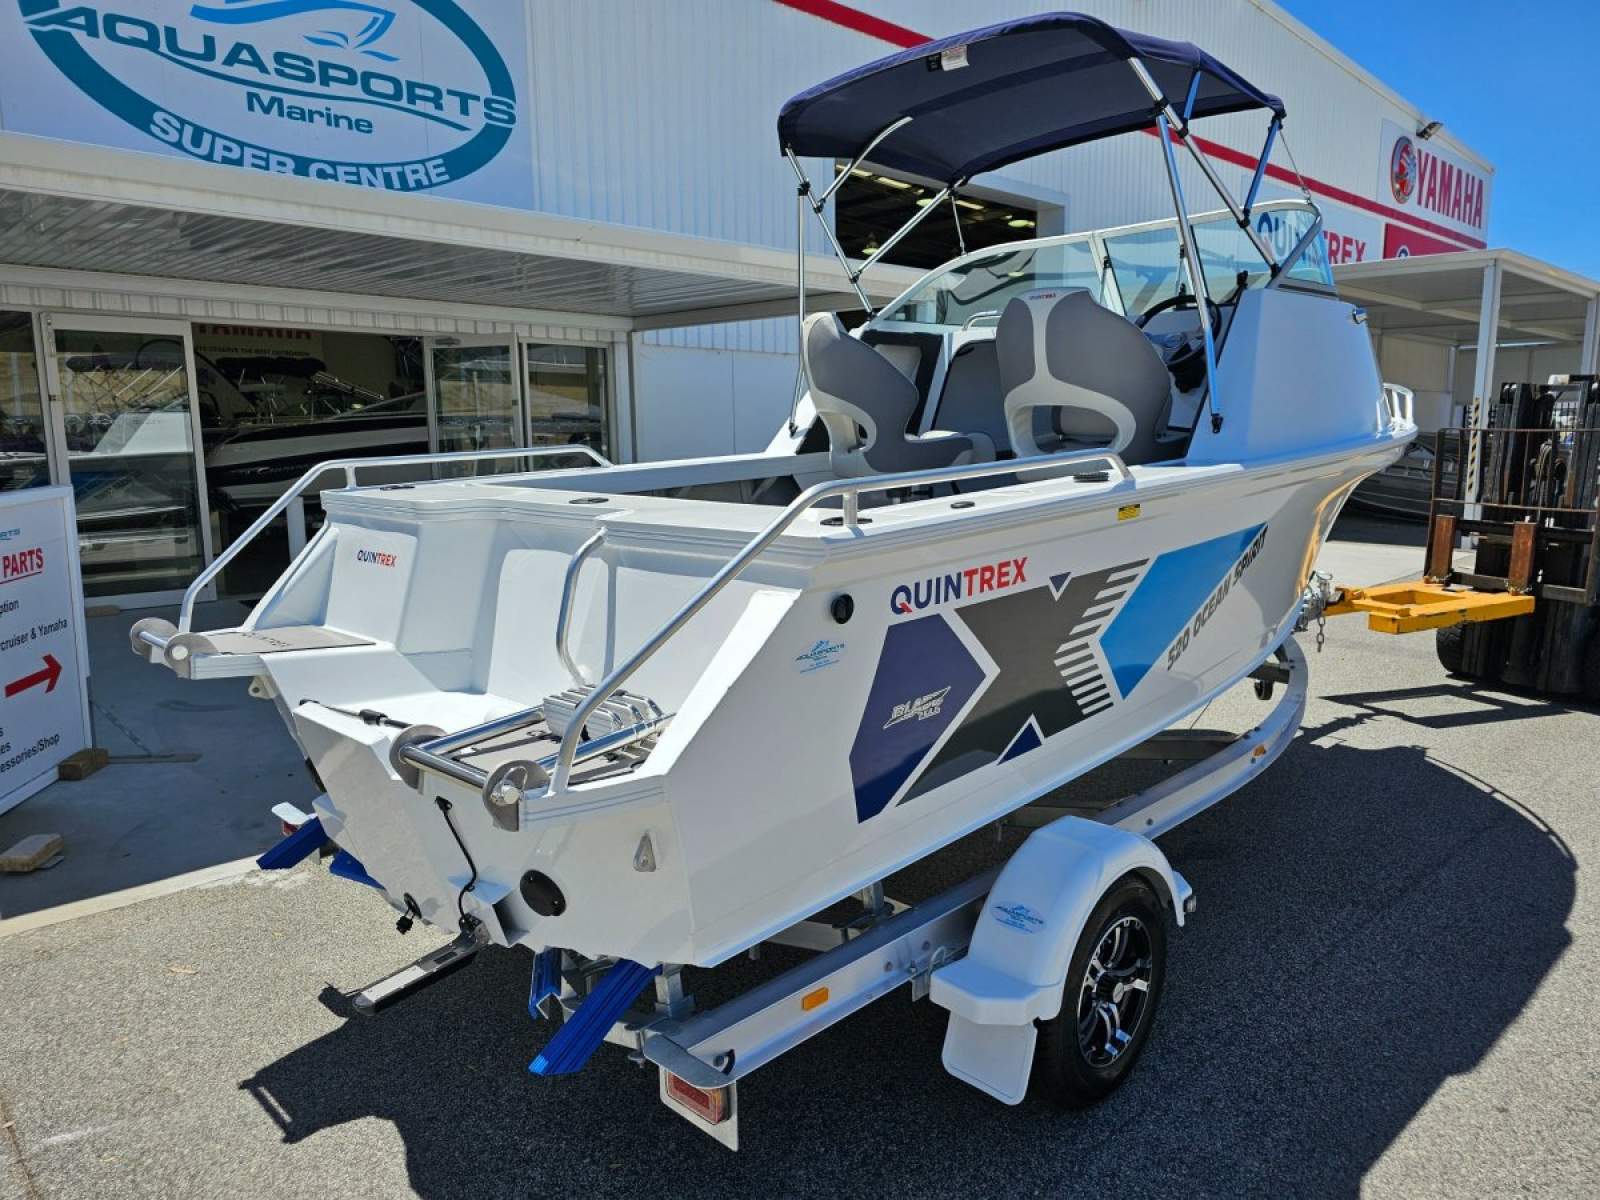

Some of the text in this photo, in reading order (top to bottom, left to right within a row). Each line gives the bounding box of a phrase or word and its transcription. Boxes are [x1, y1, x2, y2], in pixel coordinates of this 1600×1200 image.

[24, 6, 517, 126] AQUASPORTS
[246, 91, 374, 134] Marine
[150, 110, 450, 191] SUPER CENTRE
[1416, 147, 1484, 230] YAMAHA
[3, 547, 44, 579] PARTS
[356, 549, 398, 568] QUINTREX
[890, 556, 1028, 615] QUINTREX
[30, 626, 37, 640] &
[38, 618, 68, 637] Yamaha
[1193, 574, 1232, 638] OCEAN
